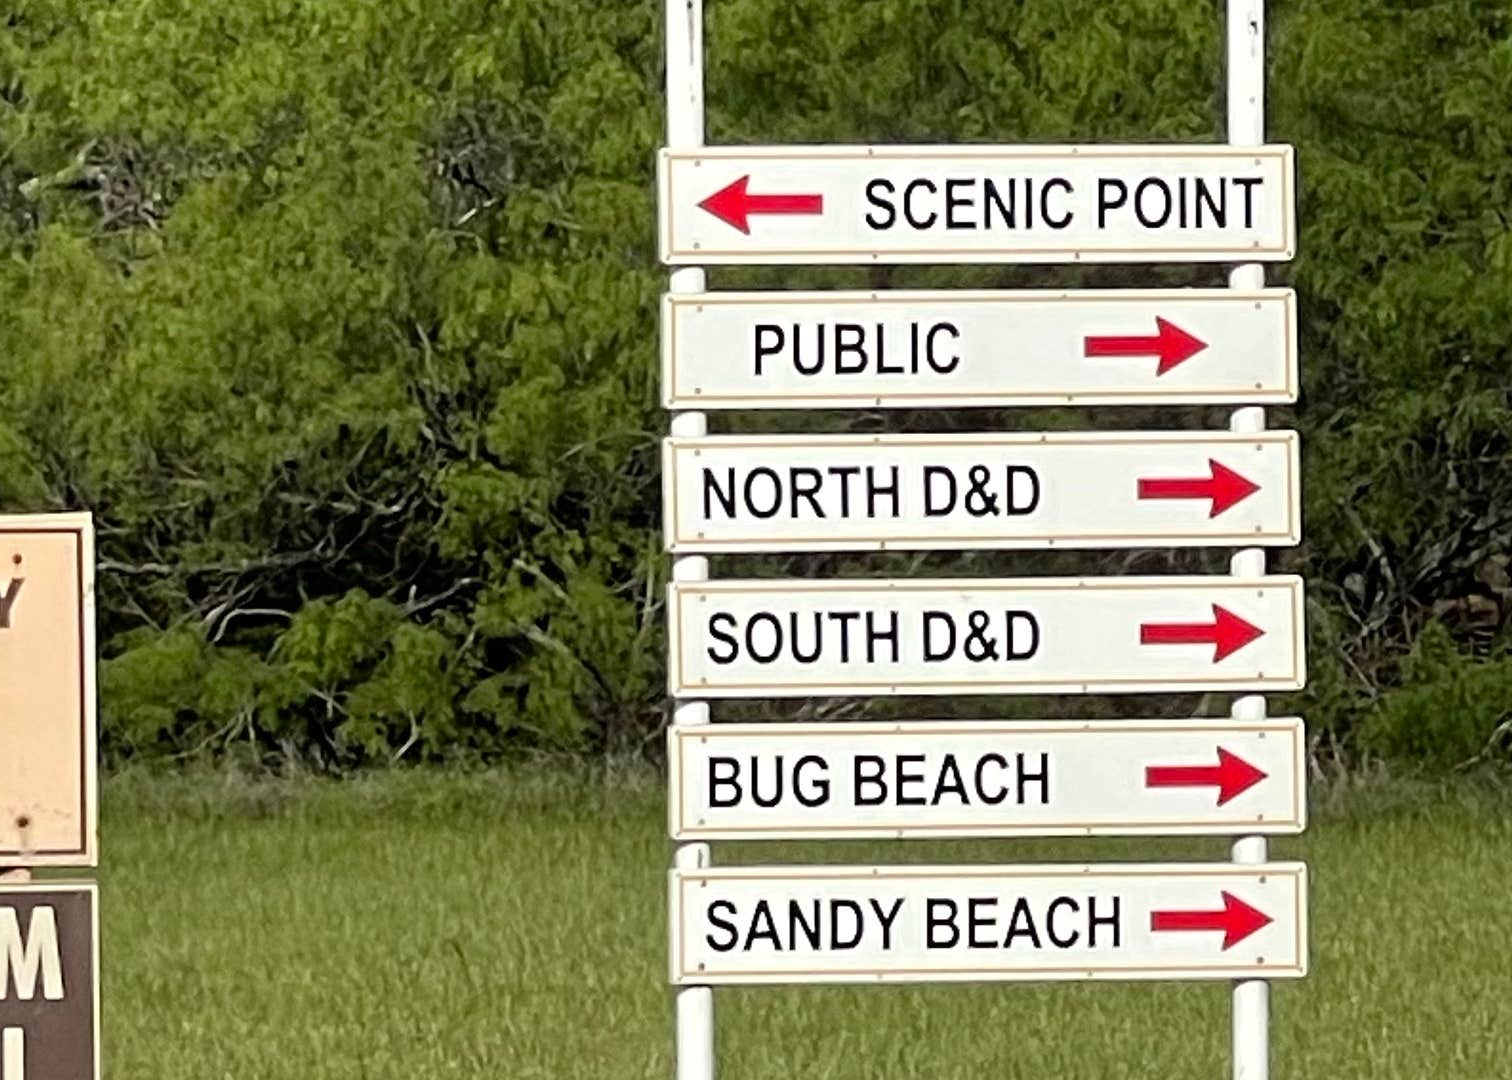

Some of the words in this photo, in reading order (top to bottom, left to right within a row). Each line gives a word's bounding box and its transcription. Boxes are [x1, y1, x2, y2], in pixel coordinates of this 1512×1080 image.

[864, 177, 1075, 231] SCENIC
[1097, 176, 1264, 231] POINT
[753, 322, 961, 376] PUBLIC
[702, 466, 900, 520] NORTH
[924, 464, 1042, 517] D&D
[706, 610, 900, 664] SOUTH
[923, 609, 1042, 663] D&D
[708, 754, 832, 809] BUG
[853, 752, 1050, 807] BEACH
[705, 897, 906, 953] SANDY
[926, 896, 1122, 950] BEACH
